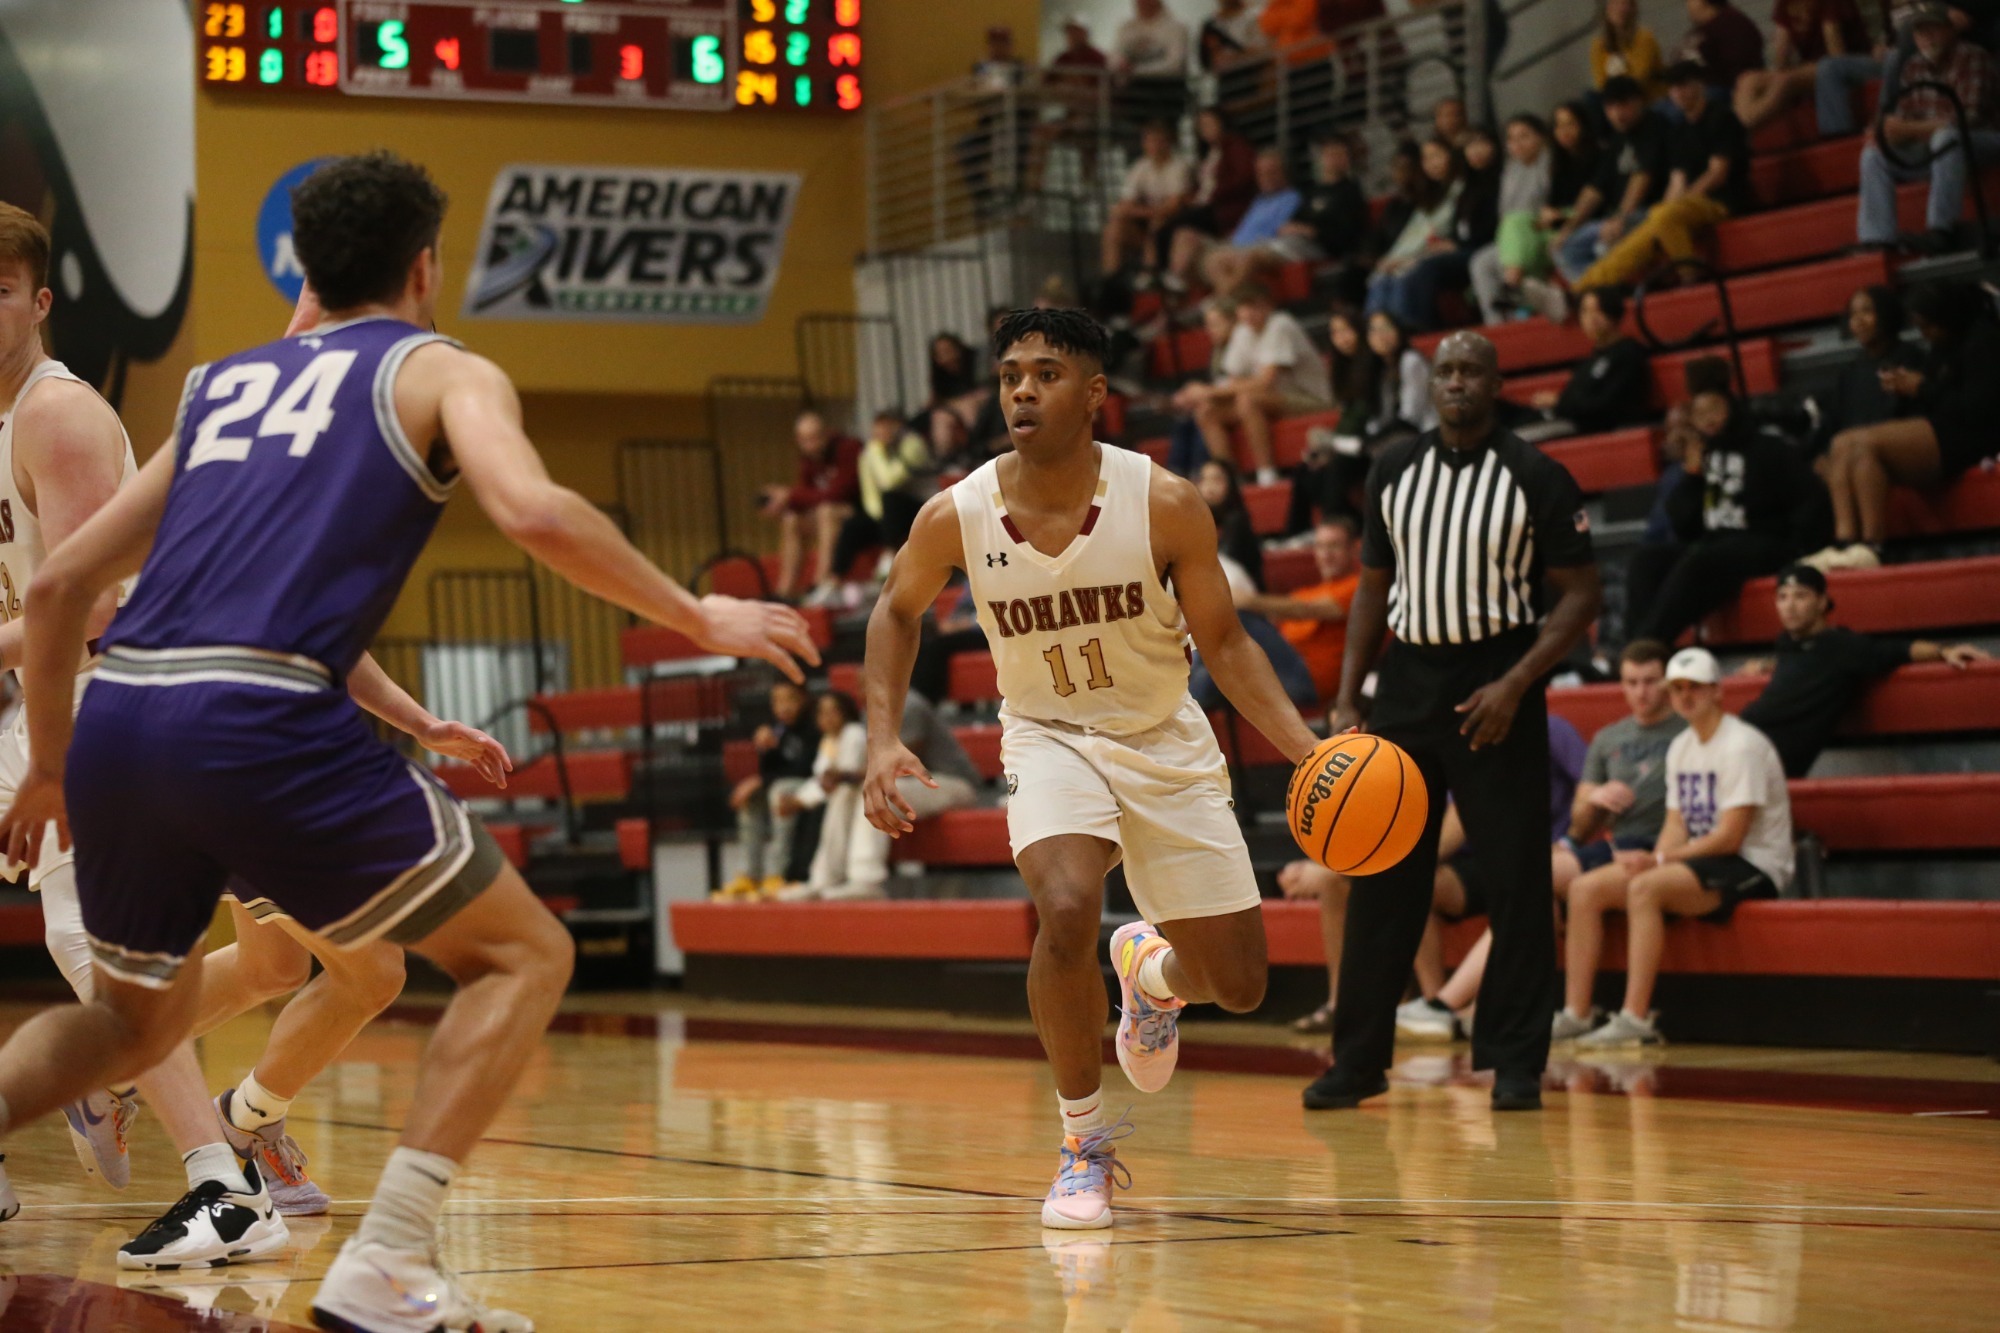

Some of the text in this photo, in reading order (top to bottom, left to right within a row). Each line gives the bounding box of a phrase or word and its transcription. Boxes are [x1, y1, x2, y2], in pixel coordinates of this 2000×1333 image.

[205, 3, 245, 37] 23
[205, 47, 246, 81] 33
[377, 20, 409, 69] 5
[620, 44, 643, 80] 3
[692, 35, 724, 84] 6
[500, 172, 788, 222] AMERICAN
[185, 350, 359, 471] 24
[987, 581, 1146, 638] KOHAWKS
[1042, 638, 1114, 698] 11
[1300, 751, 1358, 837] Wilson
